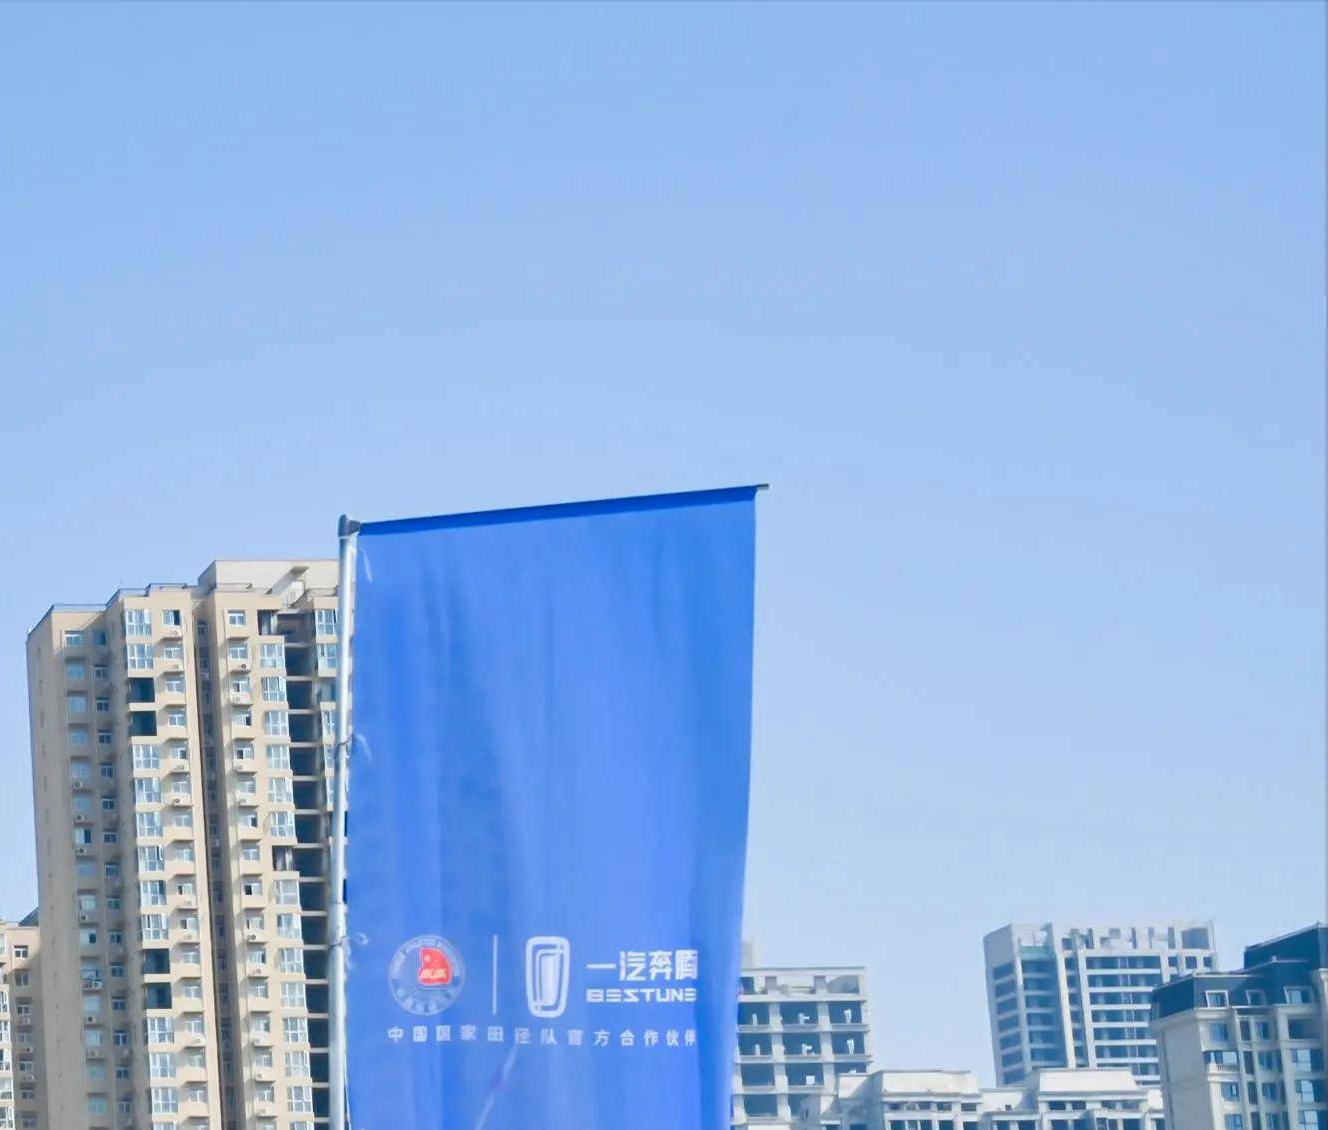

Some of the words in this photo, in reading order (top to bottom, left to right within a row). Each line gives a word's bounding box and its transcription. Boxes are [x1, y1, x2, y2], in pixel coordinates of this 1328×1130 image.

[586, 949, 698, 981] 一汽奔腾
[586, 987, 697, 1003] BESTUNE
[387, 1025, 696, 1047] 中国国家田径队官方合作伙伴
